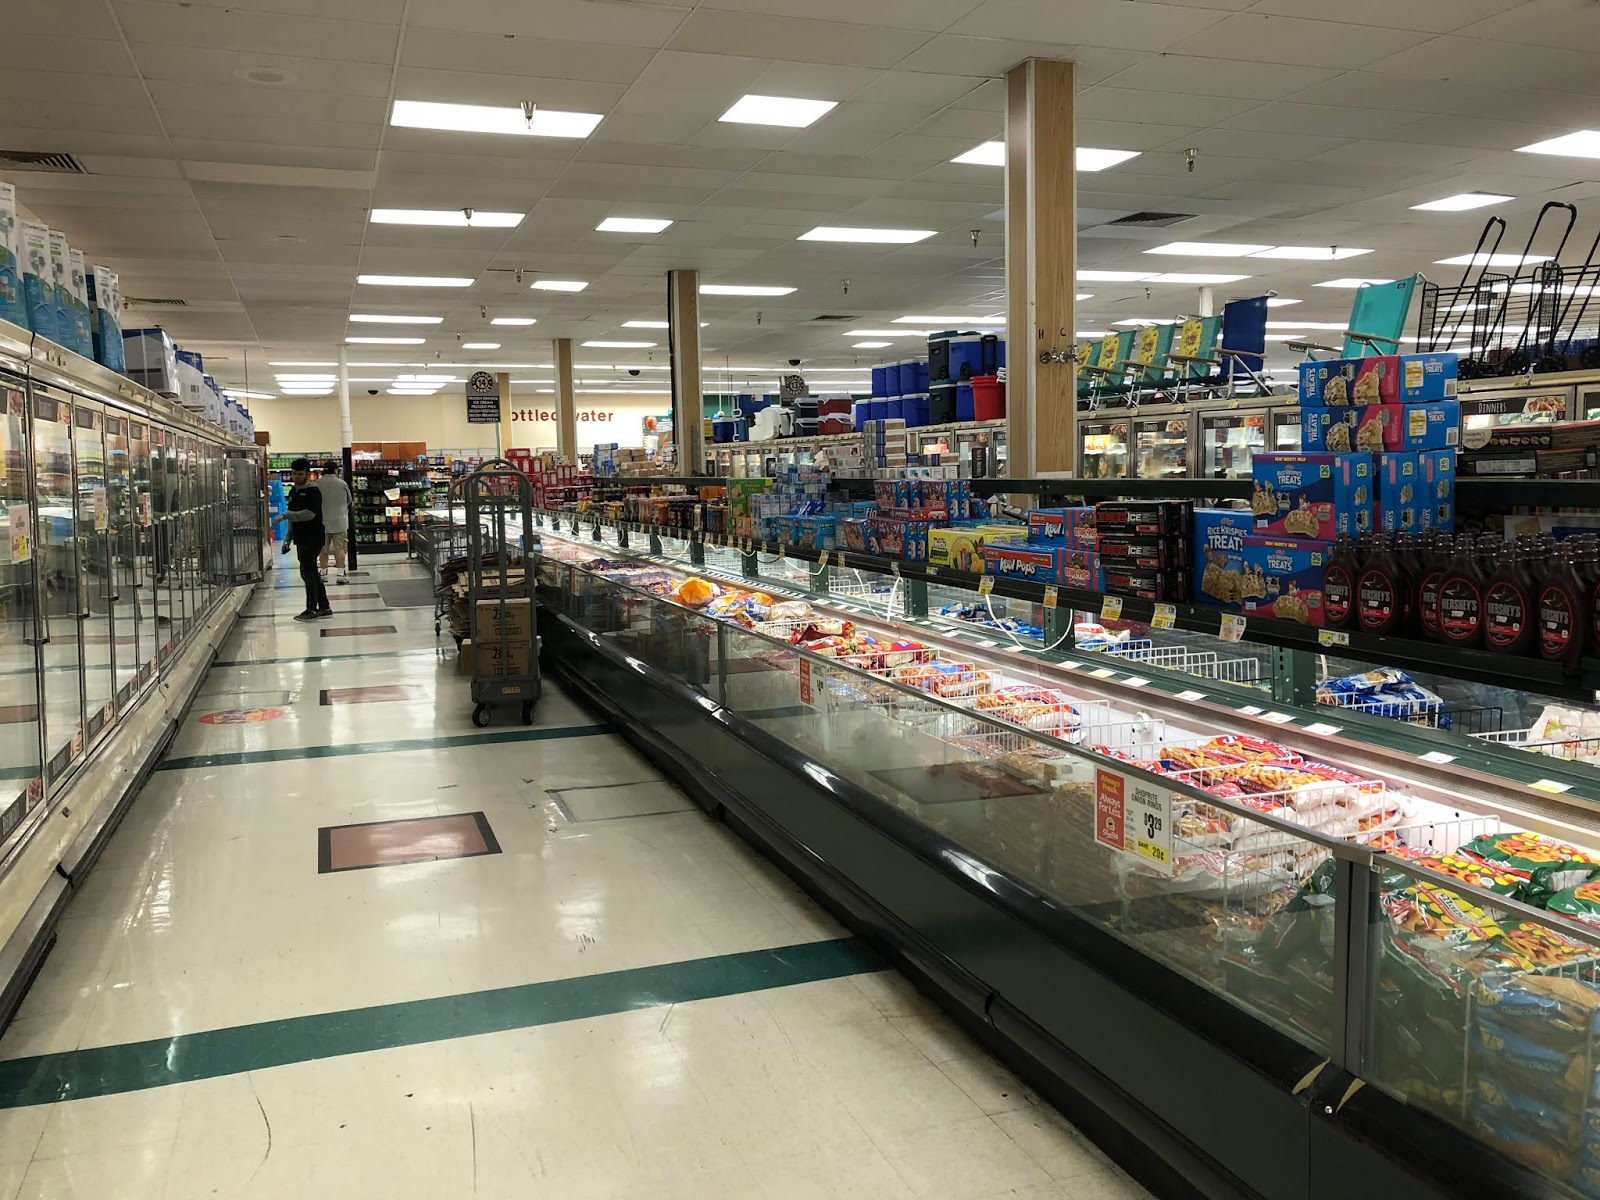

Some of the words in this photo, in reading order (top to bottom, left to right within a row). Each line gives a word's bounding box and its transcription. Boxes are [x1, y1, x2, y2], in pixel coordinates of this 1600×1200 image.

[1038, 328, 1045, 340] H
[1059, 327, 1067, 337] C
[478, 379, 487, 387] 14
[1478, 402, 1507, 414] DINNERS
[512, 409, 557, 422] ottle
[576, 410, 614, 422] ater
[1311, 413, 1319, 442] TREATS
[1277, 475, 1302, 486] TREATS
[1127, 511, 1142, 523] ICE
[1044, 522, 1062, 538] Kool
[1207, 526, 1221, 536] RICE
[1221, 525, 1248, 537] KRISPIES
[1128, 545, 1143, 557] ICE
[1000, 557, 1015, 573] Kool
[1016, 559, 1036, 576] Pops
[1267, 560, 1292, 571] TREATS
[1130, 577, 1142, 588] ICE
[1361, 589, 1391, 602] HERSHEY'S
[1442, 598, 1478, 612] HERSHEY'S
[1488, 602, 1522, 618] HERSHEY'S
[1541, 610, 1569, 625] HERSHEY'S
[1100, 792, 1121, 809] Always
[1134, 787, 1158, 803] SHOPRITE
[1098, 801, 1109, 813] For
[1131, 793, 1146, 806] ONION
[1146, 799, 1162, 811] RINGS
[1138, 841, 1149, 850] SAVE
